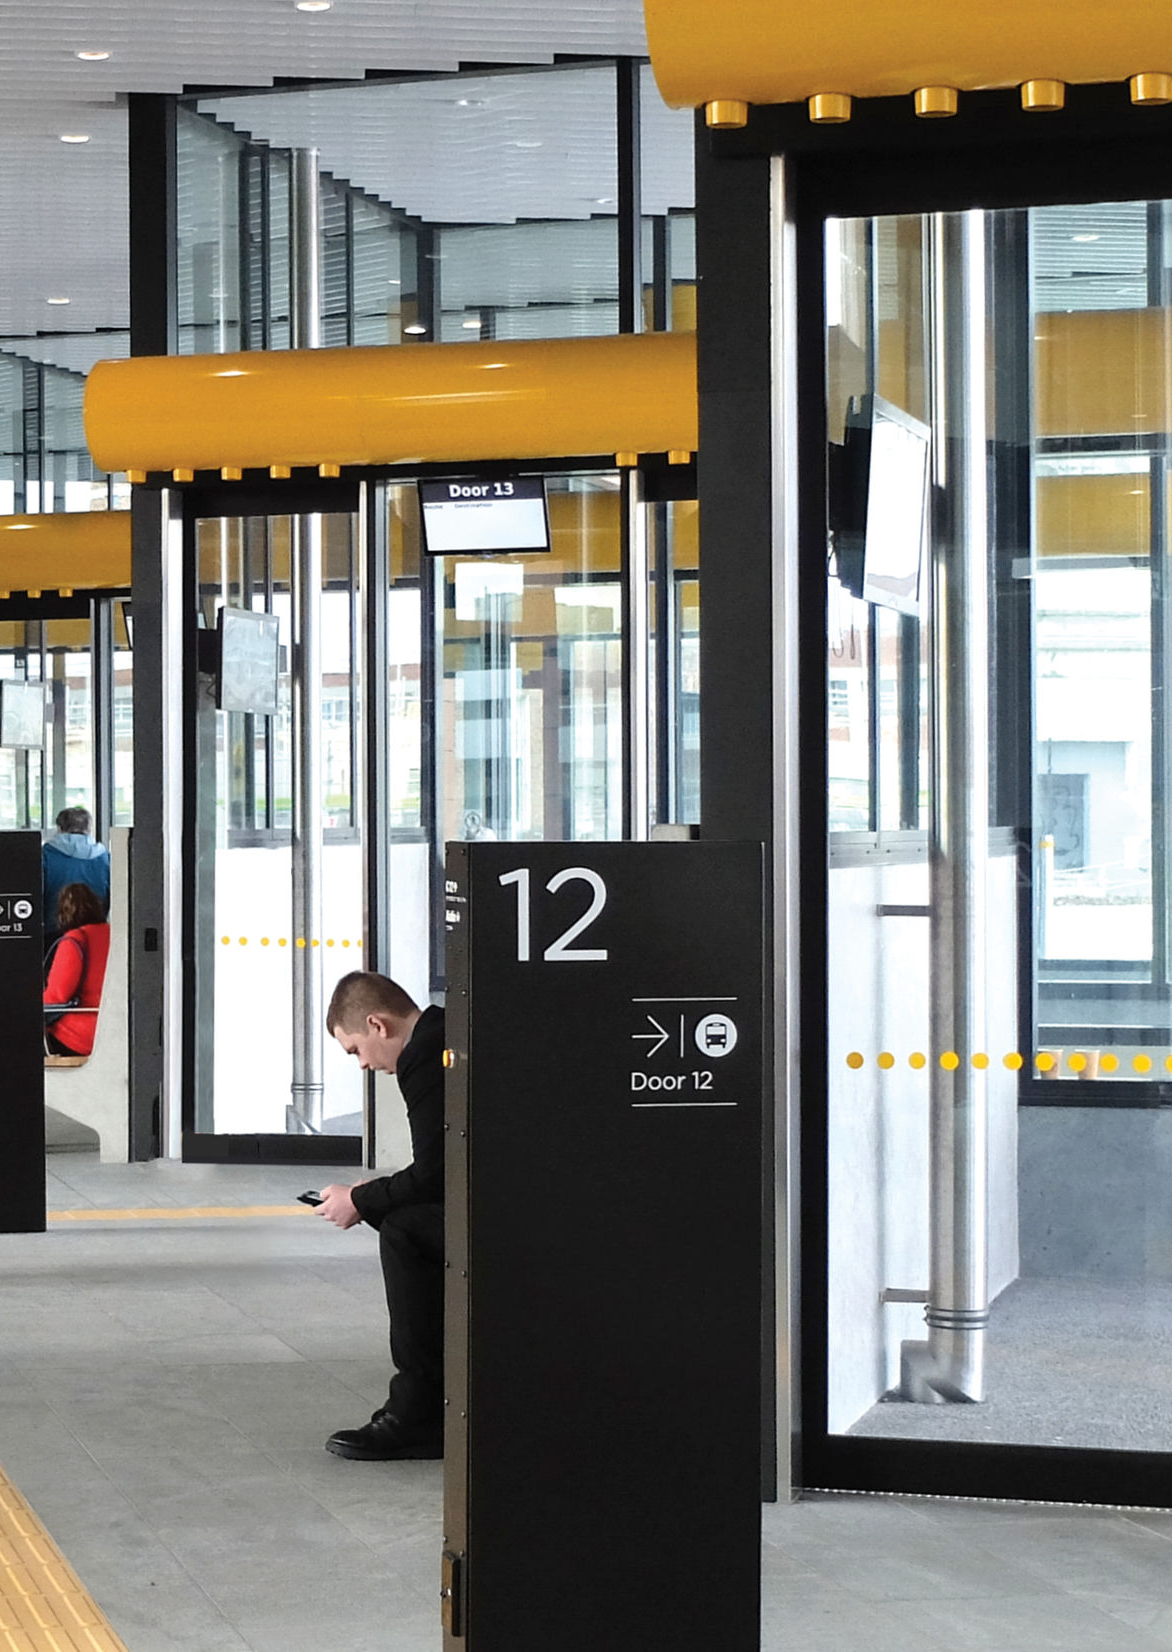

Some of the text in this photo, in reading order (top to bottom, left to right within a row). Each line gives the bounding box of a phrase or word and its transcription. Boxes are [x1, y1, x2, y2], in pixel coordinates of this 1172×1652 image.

[448, 481, 514, 498] Door 13
[498, 867, 608, 962] 12
[13, 923, 23, 932] 13
[631, 1070, 713, 1091] Door 12
